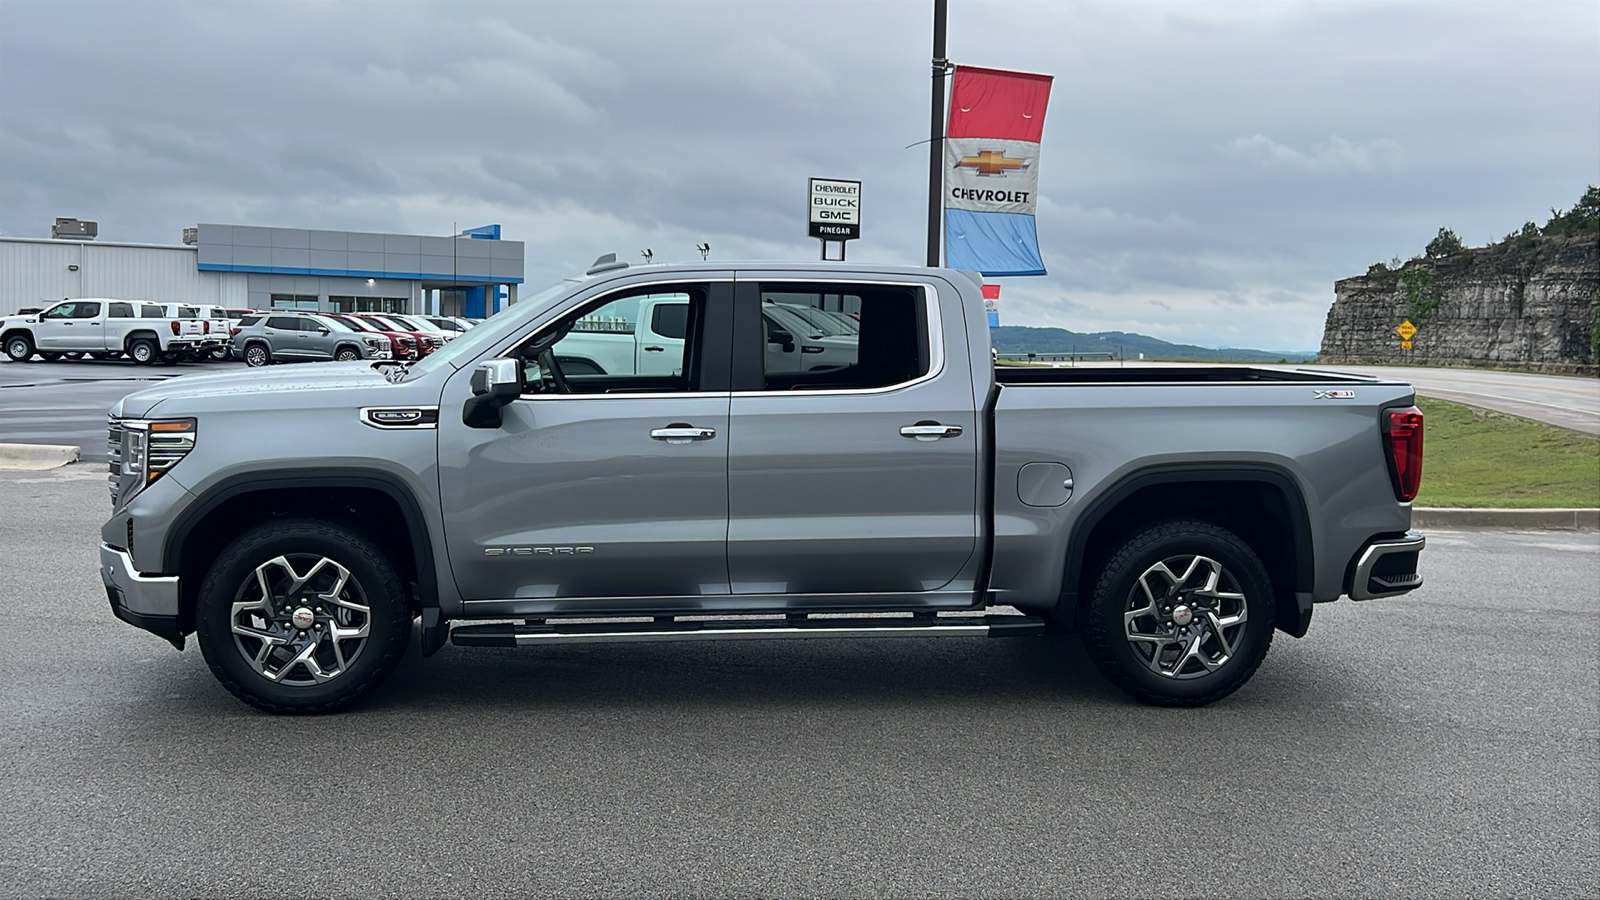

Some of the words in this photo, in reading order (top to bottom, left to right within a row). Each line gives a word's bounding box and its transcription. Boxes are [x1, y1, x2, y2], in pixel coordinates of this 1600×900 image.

[815, 185, 857, 194] CHEVROLET
[952, 187, 1030, 204] CHEVROLET
[814, 197, 857, 207] BUICK
[820, 211, 851, 220] GMC
[819, 226, 851, 235] PINEGAR
[484, 547, 594, 556] SIERRA
